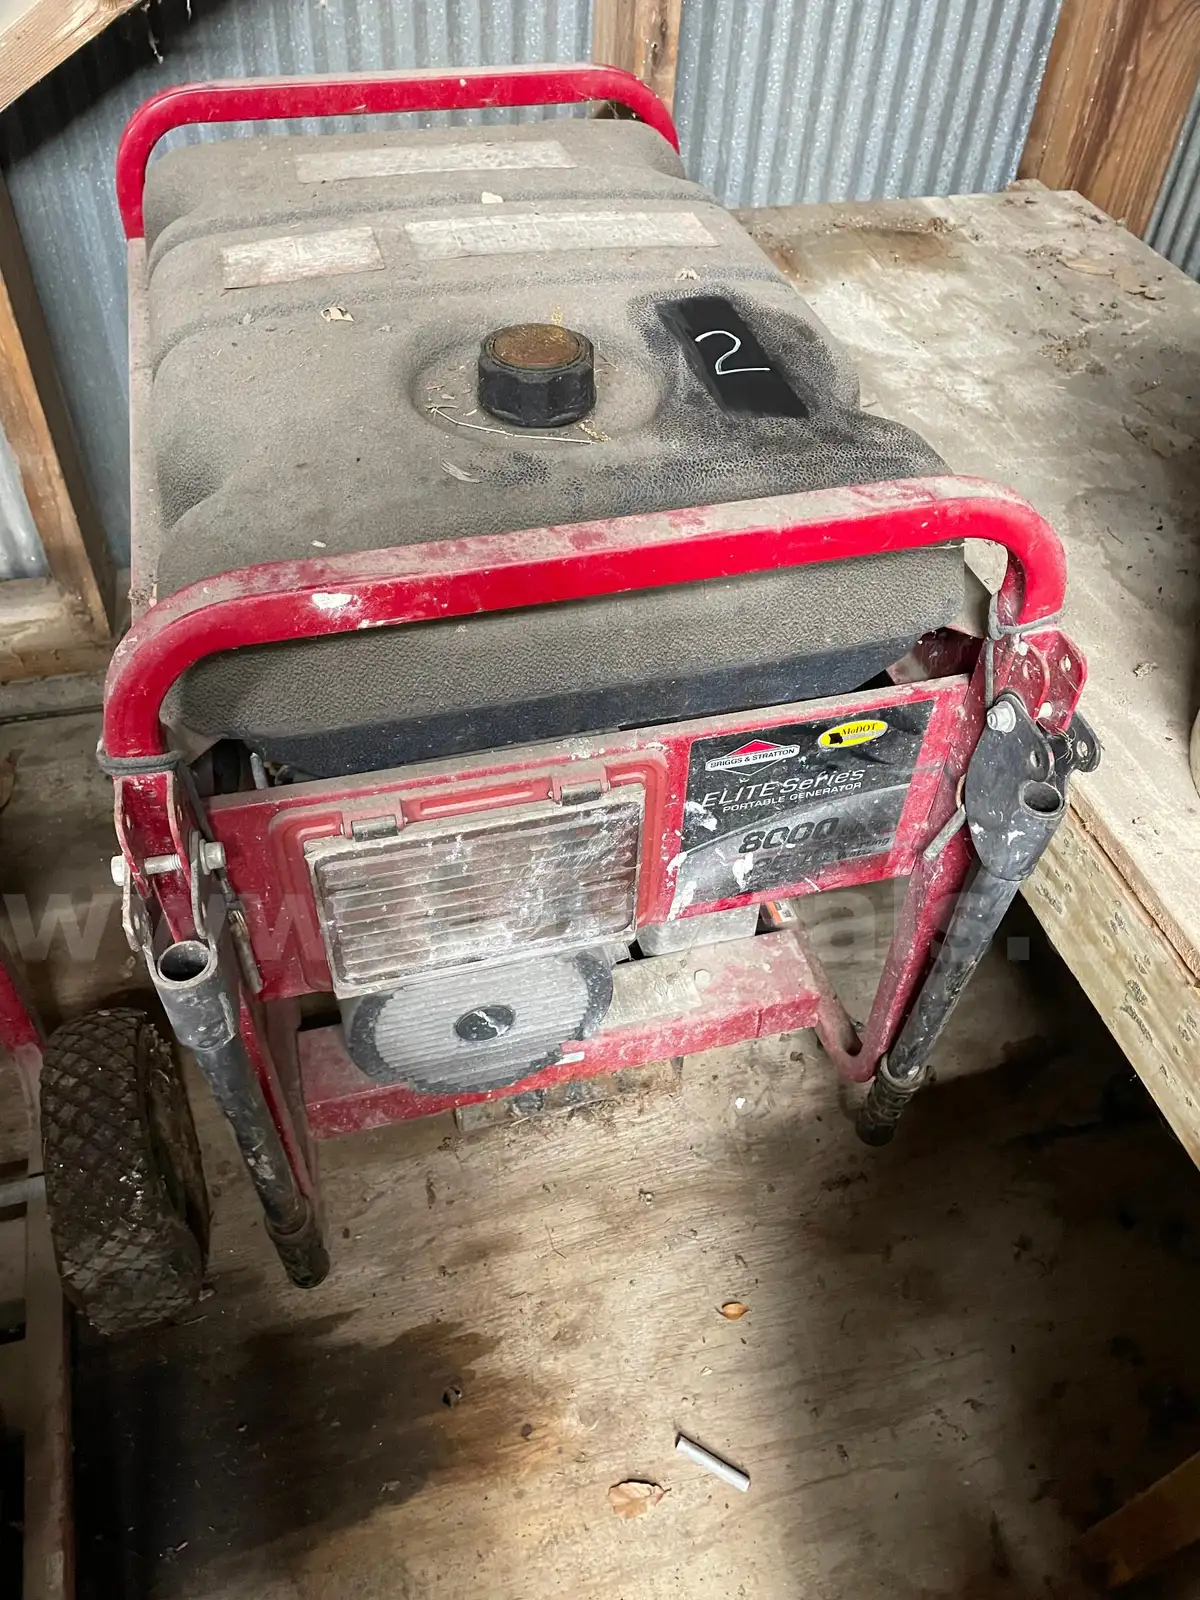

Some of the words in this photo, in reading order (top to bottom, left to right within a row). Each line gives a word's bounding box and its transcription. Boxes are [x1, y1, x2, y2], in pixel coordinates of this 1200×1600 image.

[695, 330, 770, 375] 2
[842, 723, 878, 735] MoDOT
[710, 758, 742, 768] BRIGGS
[752, 748, 795, 760] STRATTON
[701, 781, 779, 807] ELITE
[779, 769, 866, 794] Series
[722, 796, 785, 812] PORTABLE
[790, 782, 862, 801] GENERATOR
[738, 817, 840, 853] 8000
